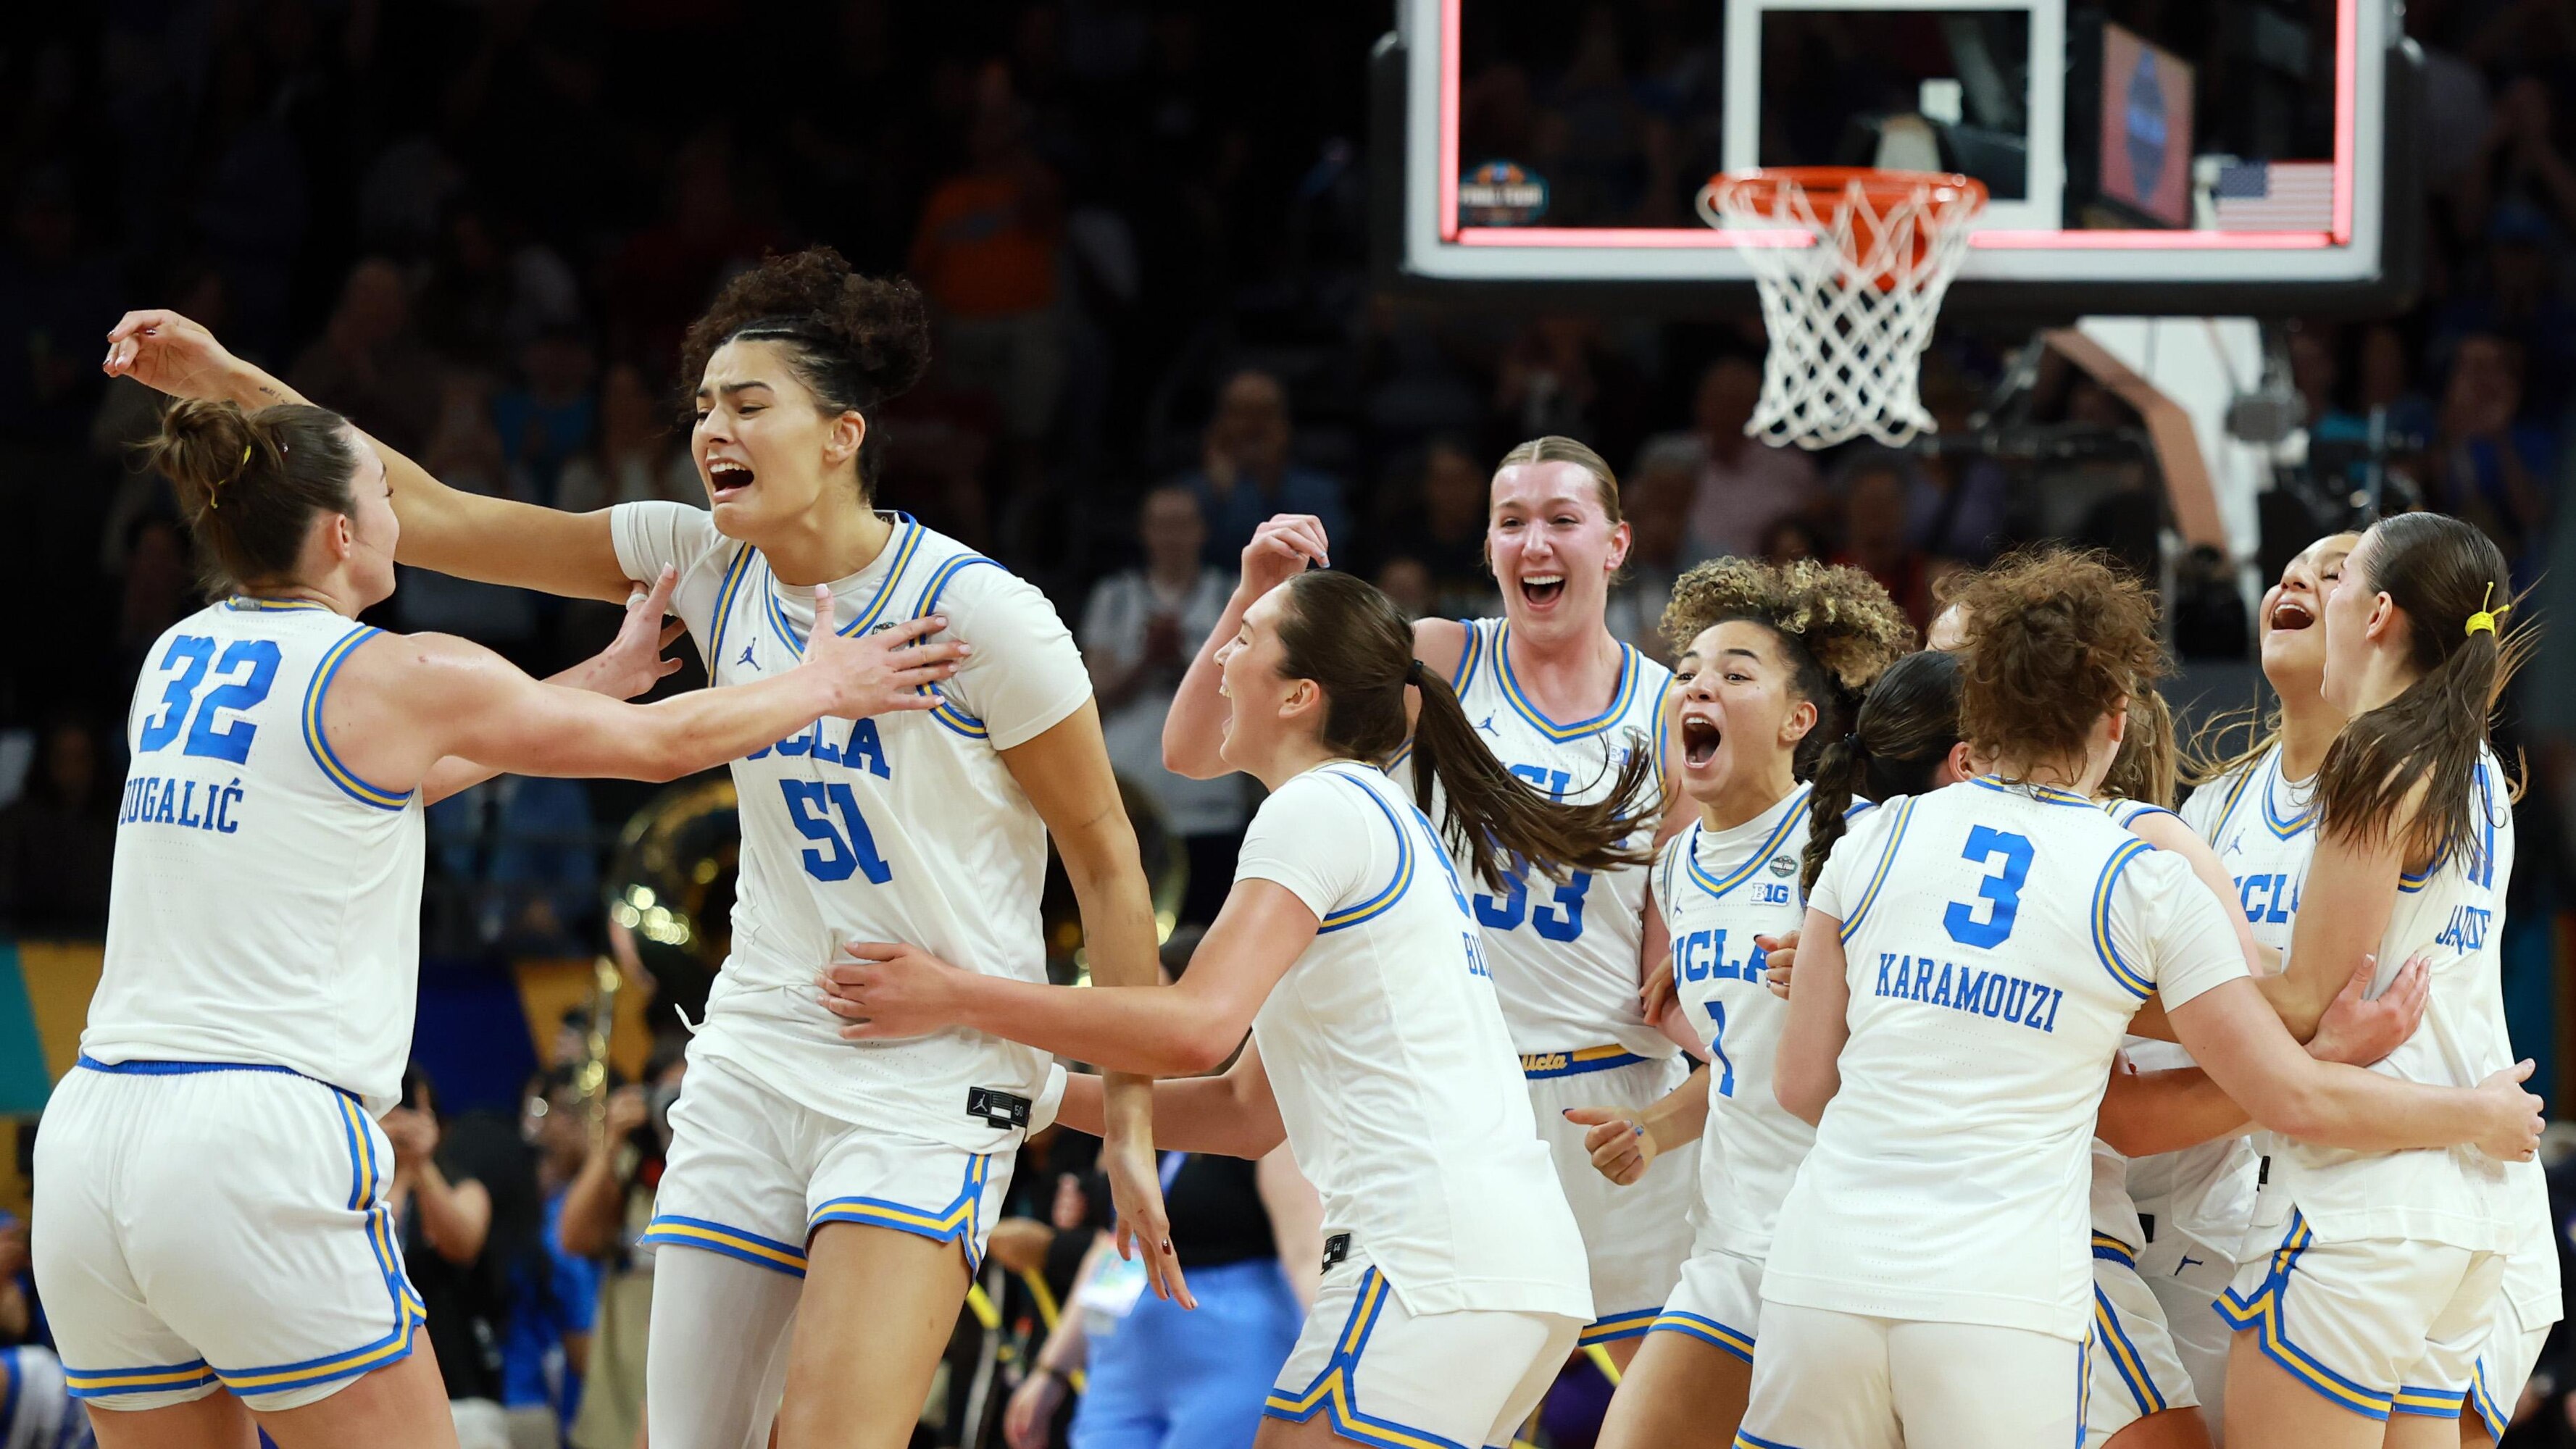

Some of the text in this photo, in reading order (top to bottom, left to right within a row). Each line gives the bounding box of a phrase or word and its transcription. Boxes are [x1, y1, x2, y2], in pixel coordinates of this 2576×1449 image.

[139, 635, 282, 765] 32
[778, 779, 893, 885] 51
[1943, 824, 2035, 950] 3
[1875, 953, 2063, 1032] KARAMOUZI
[1704, 1001, 1735, 1098] 1
[1014, 1105, 1024, 1116] 50
